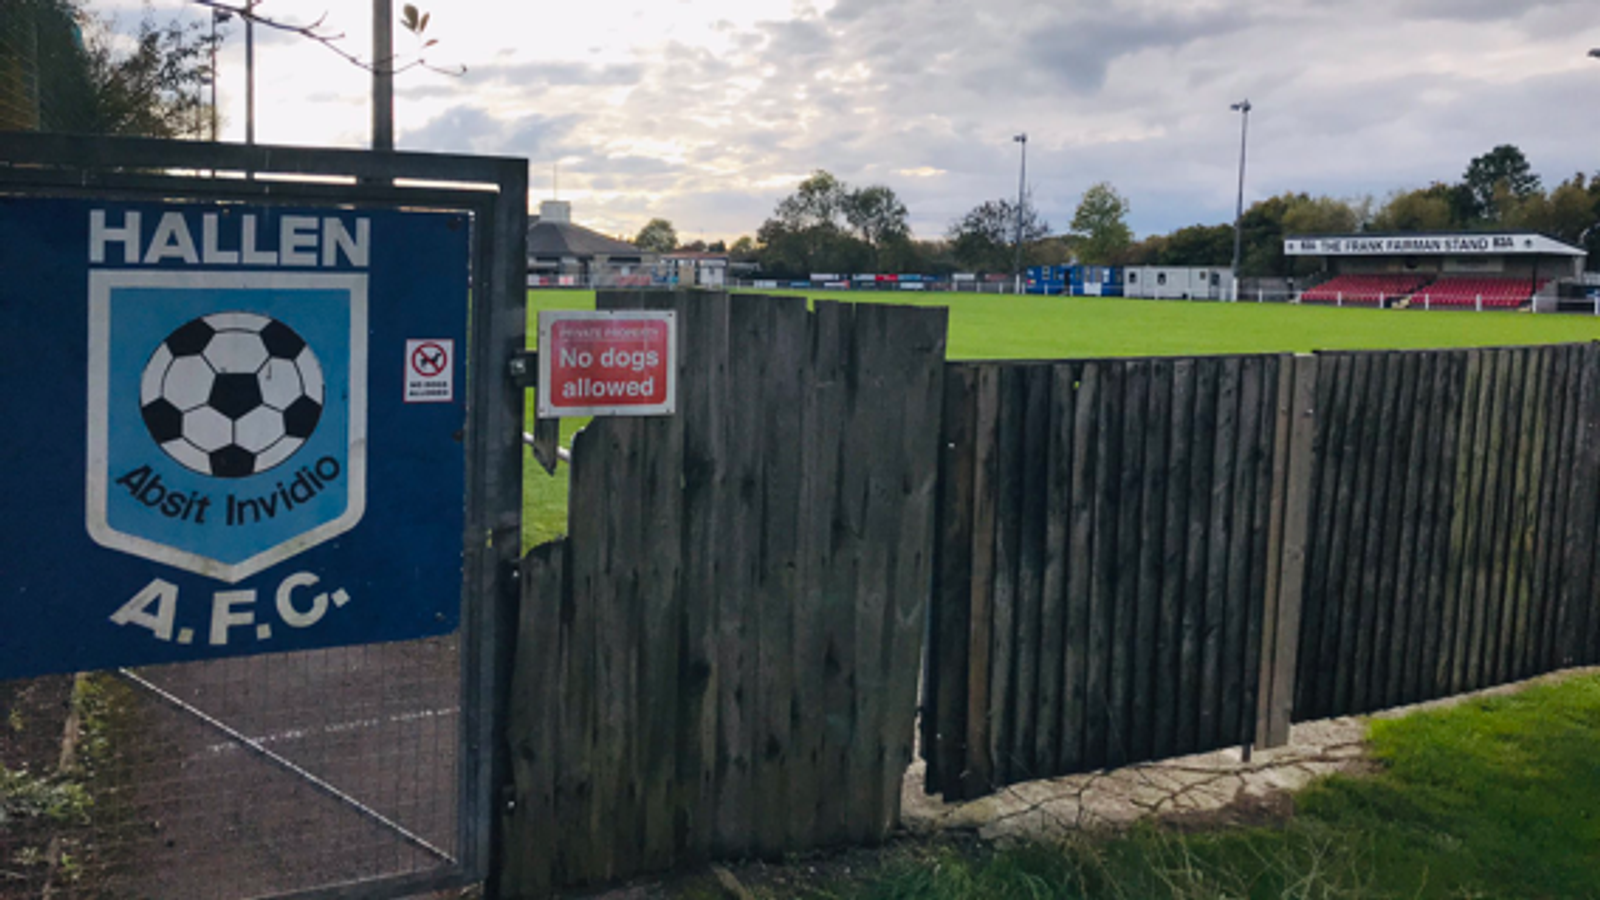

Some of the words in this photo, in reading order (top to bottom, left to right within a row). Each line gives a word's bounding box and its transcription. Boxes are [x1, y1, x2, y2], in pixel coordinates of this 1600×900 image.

[89, 210, 370, 266] HALLEN
[1321, 240, 1341, 252] THE
[1345, 240, 1383, 251] FRANK
[1445, 238, 1489, 251] STAND
[559, 347, 593, 368] No
[600, 347, 659, 371] dogs
[562, 376, 653, 398] allowed
[116, 465, 211, 524] Absit
[226, 455, 341, 526] Invidio
[110, 571, 351, 645] A.F.C.
